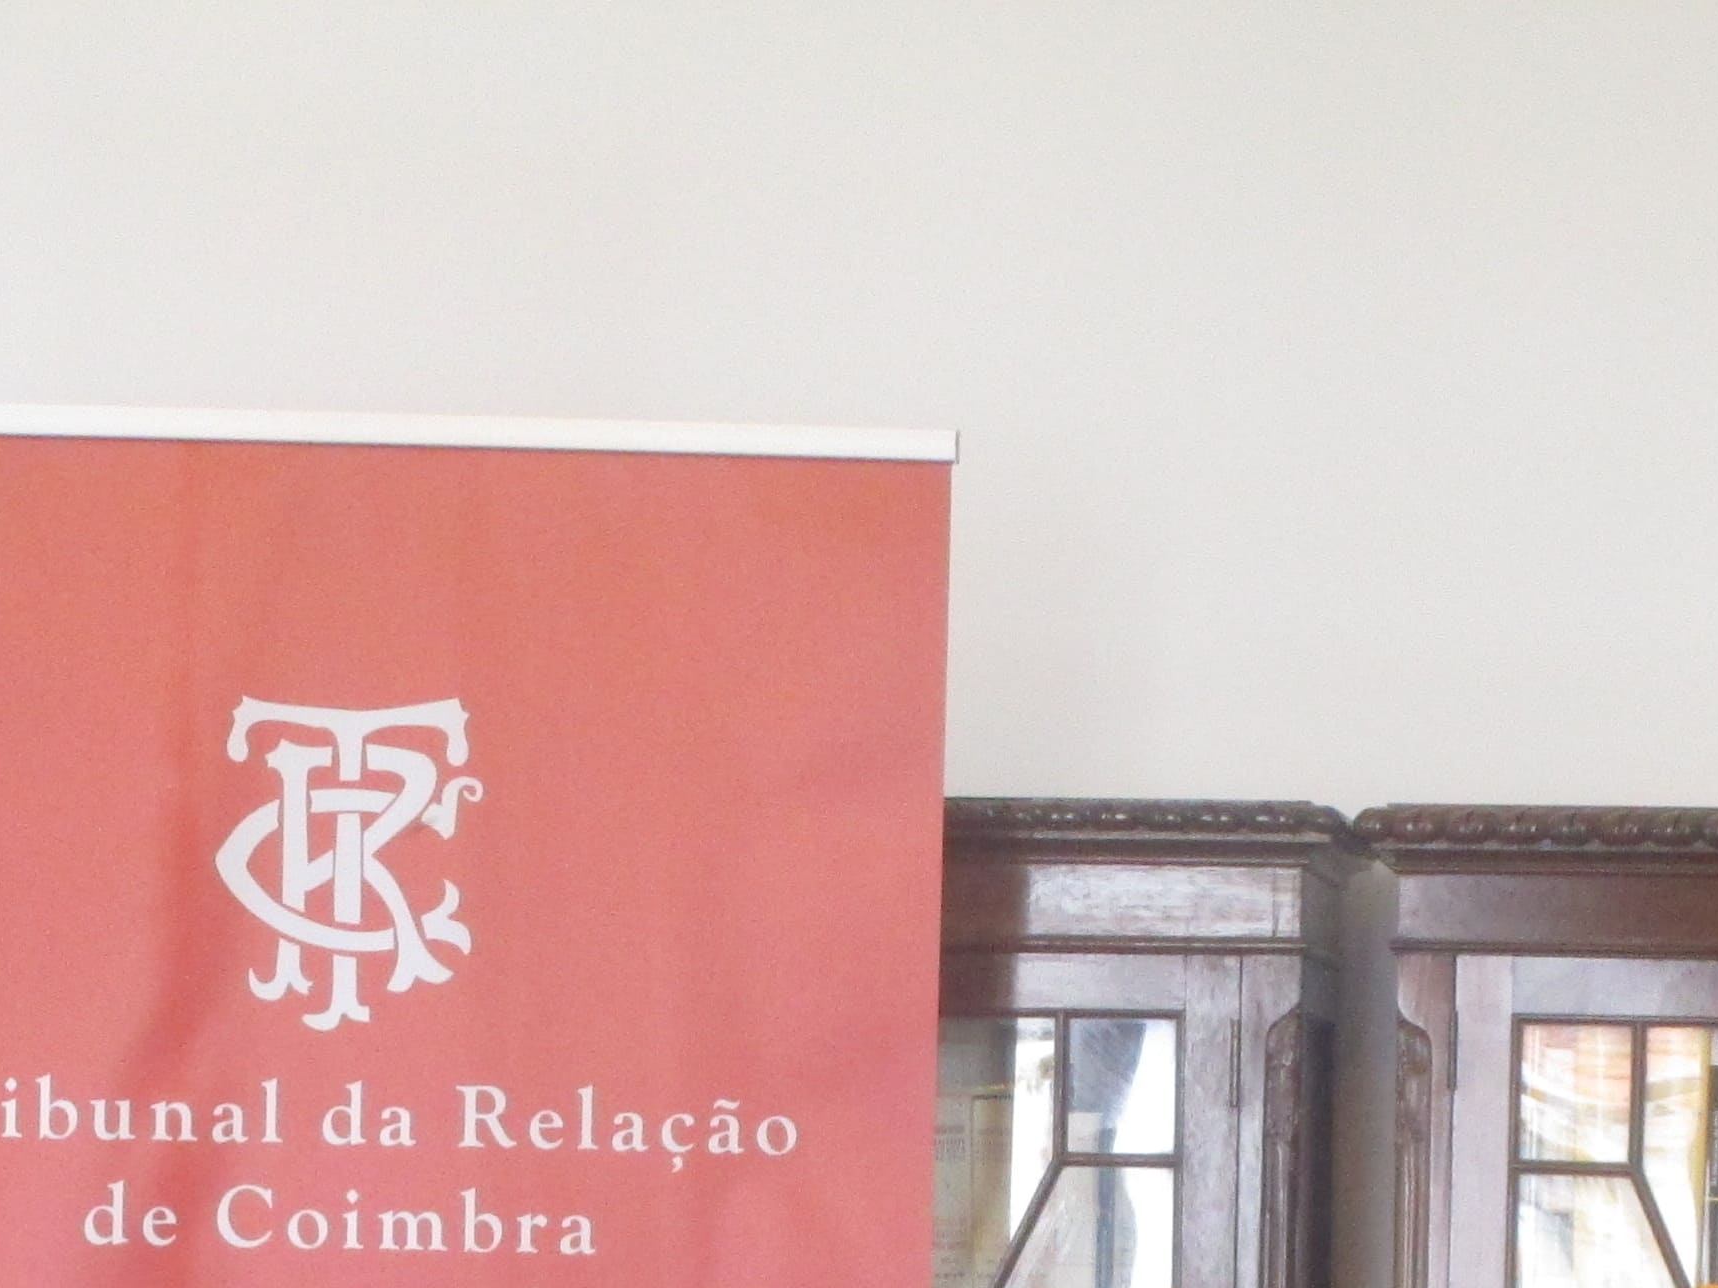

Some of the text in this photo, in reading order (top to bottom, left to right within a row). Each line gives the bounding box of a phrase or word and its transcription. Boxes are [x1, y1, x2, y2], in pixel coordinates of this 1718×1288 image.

[322, 1080, 418, 1149] da
[456, 1085, 799, 1175] Relação
[83, 1180, 598, 1257] de Coimbra
